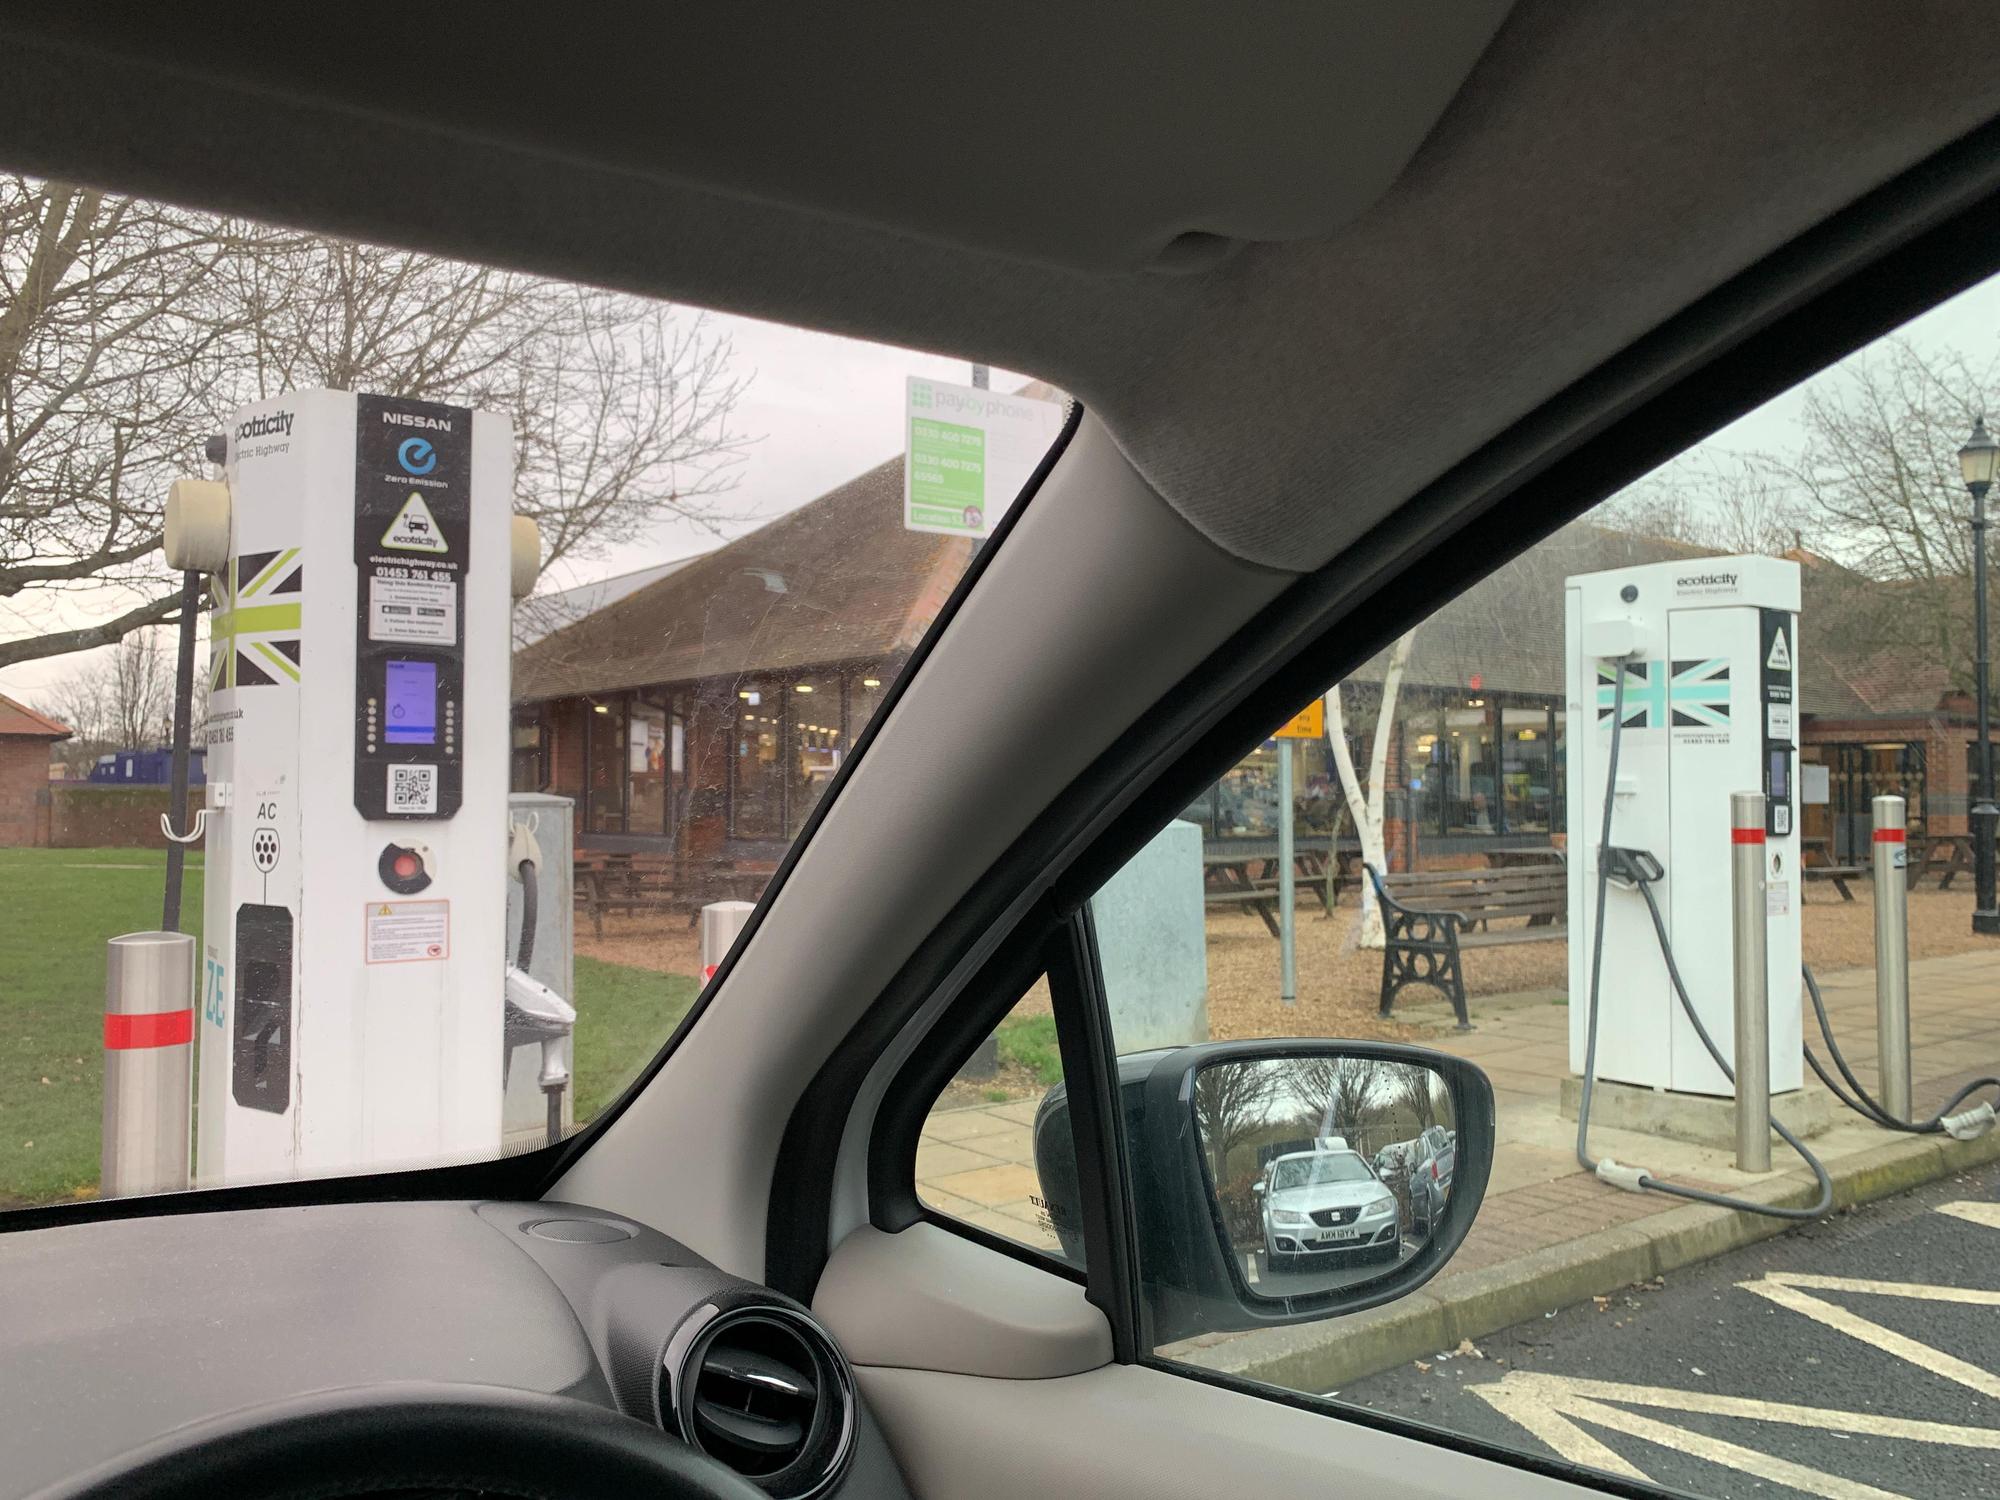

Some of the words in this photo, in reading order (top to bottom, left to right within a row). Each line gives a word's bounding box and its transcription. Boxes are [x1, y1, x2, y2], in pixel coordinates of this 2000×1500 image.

[936, 390, 1034, 422] paybyphone
[383, 411, 452, 432] NISSAN
[384, 474, 408, 484] Zero
[409, 478, 449, 489] Emission
[1677, 573, 1738, 586] ecotricity
[257, 802, 277, 820] AC
